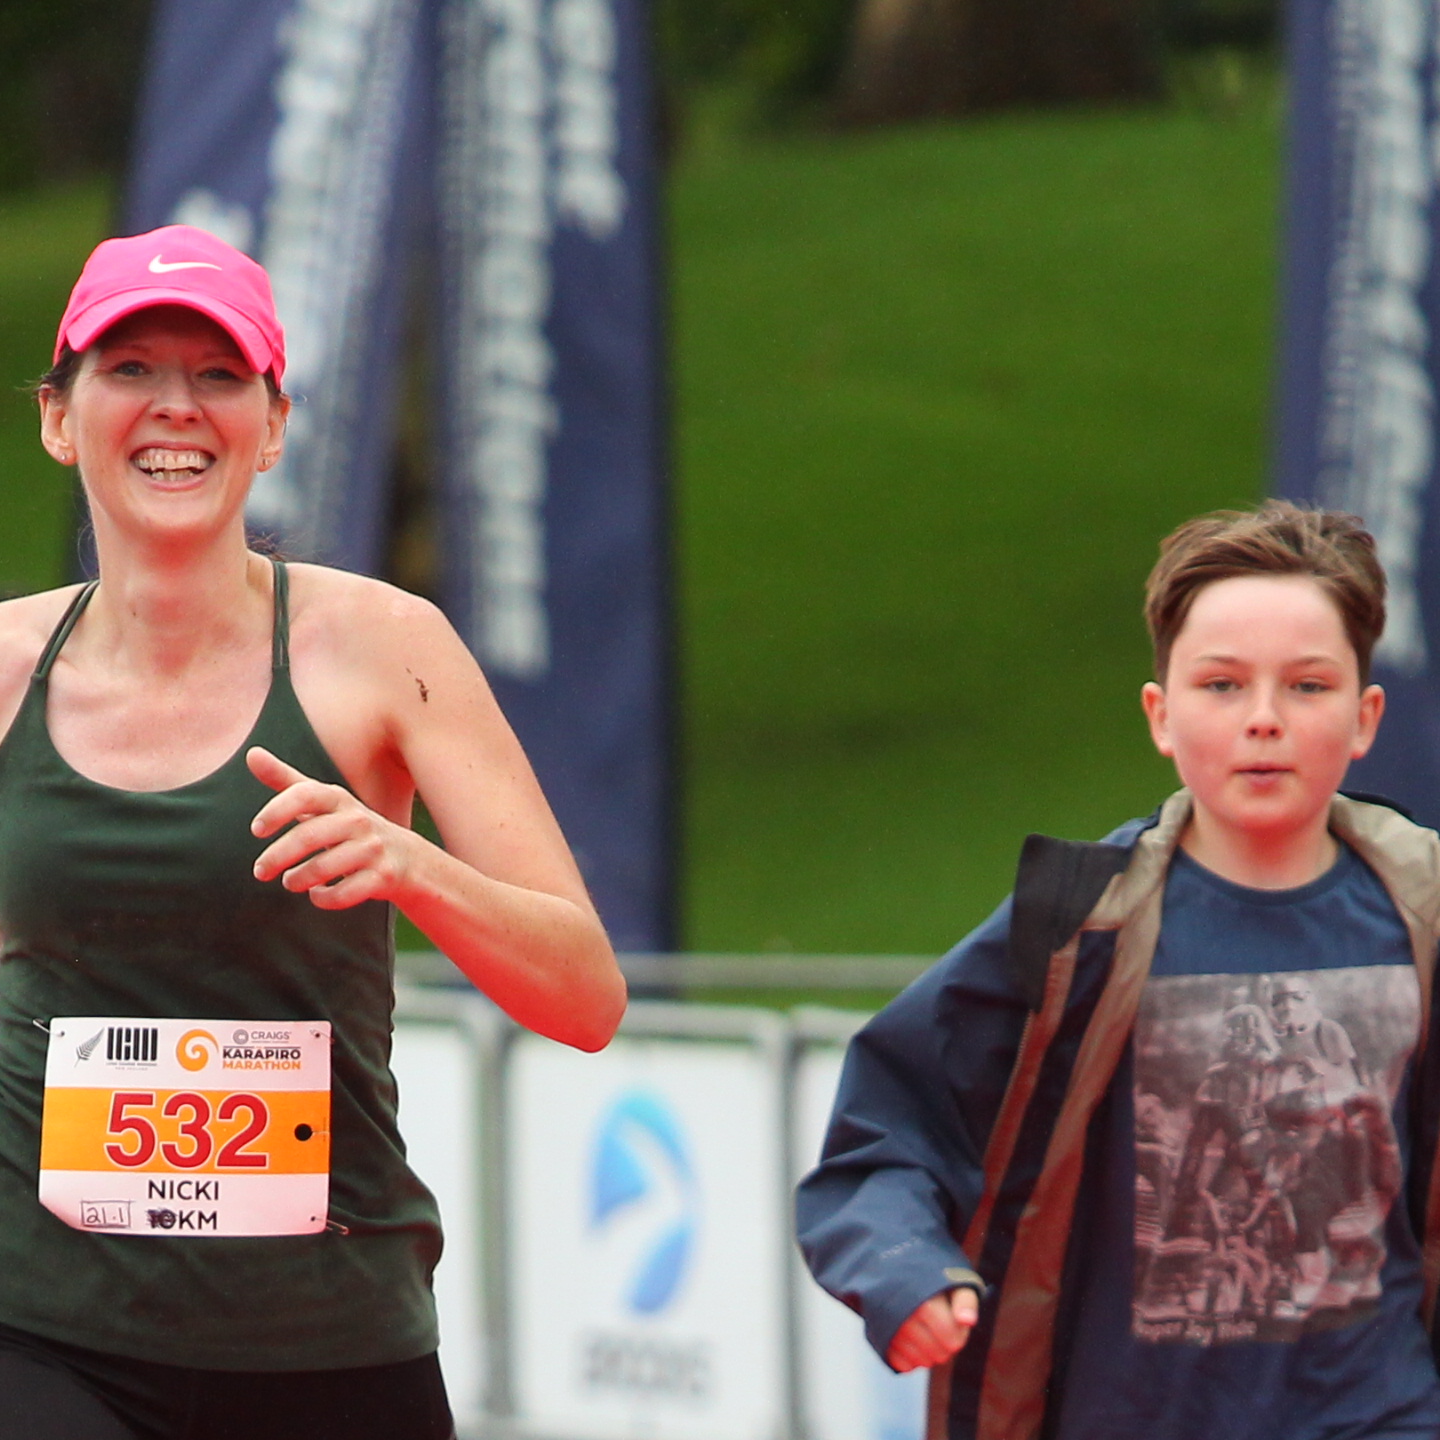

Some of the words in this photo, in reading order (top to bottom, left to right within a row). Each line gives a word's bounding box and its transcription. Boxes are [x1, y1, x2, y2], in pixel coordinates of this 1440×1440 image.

[250, 1031, 290, 1040] CRAIGS
[222, 1048, 302, 1060] KARAPIRO
[222, 1060, 302, 1071] MARATHON
[104, 1090, 269, 1169] 532
[148, 1179, 220, 1201] NICKI
